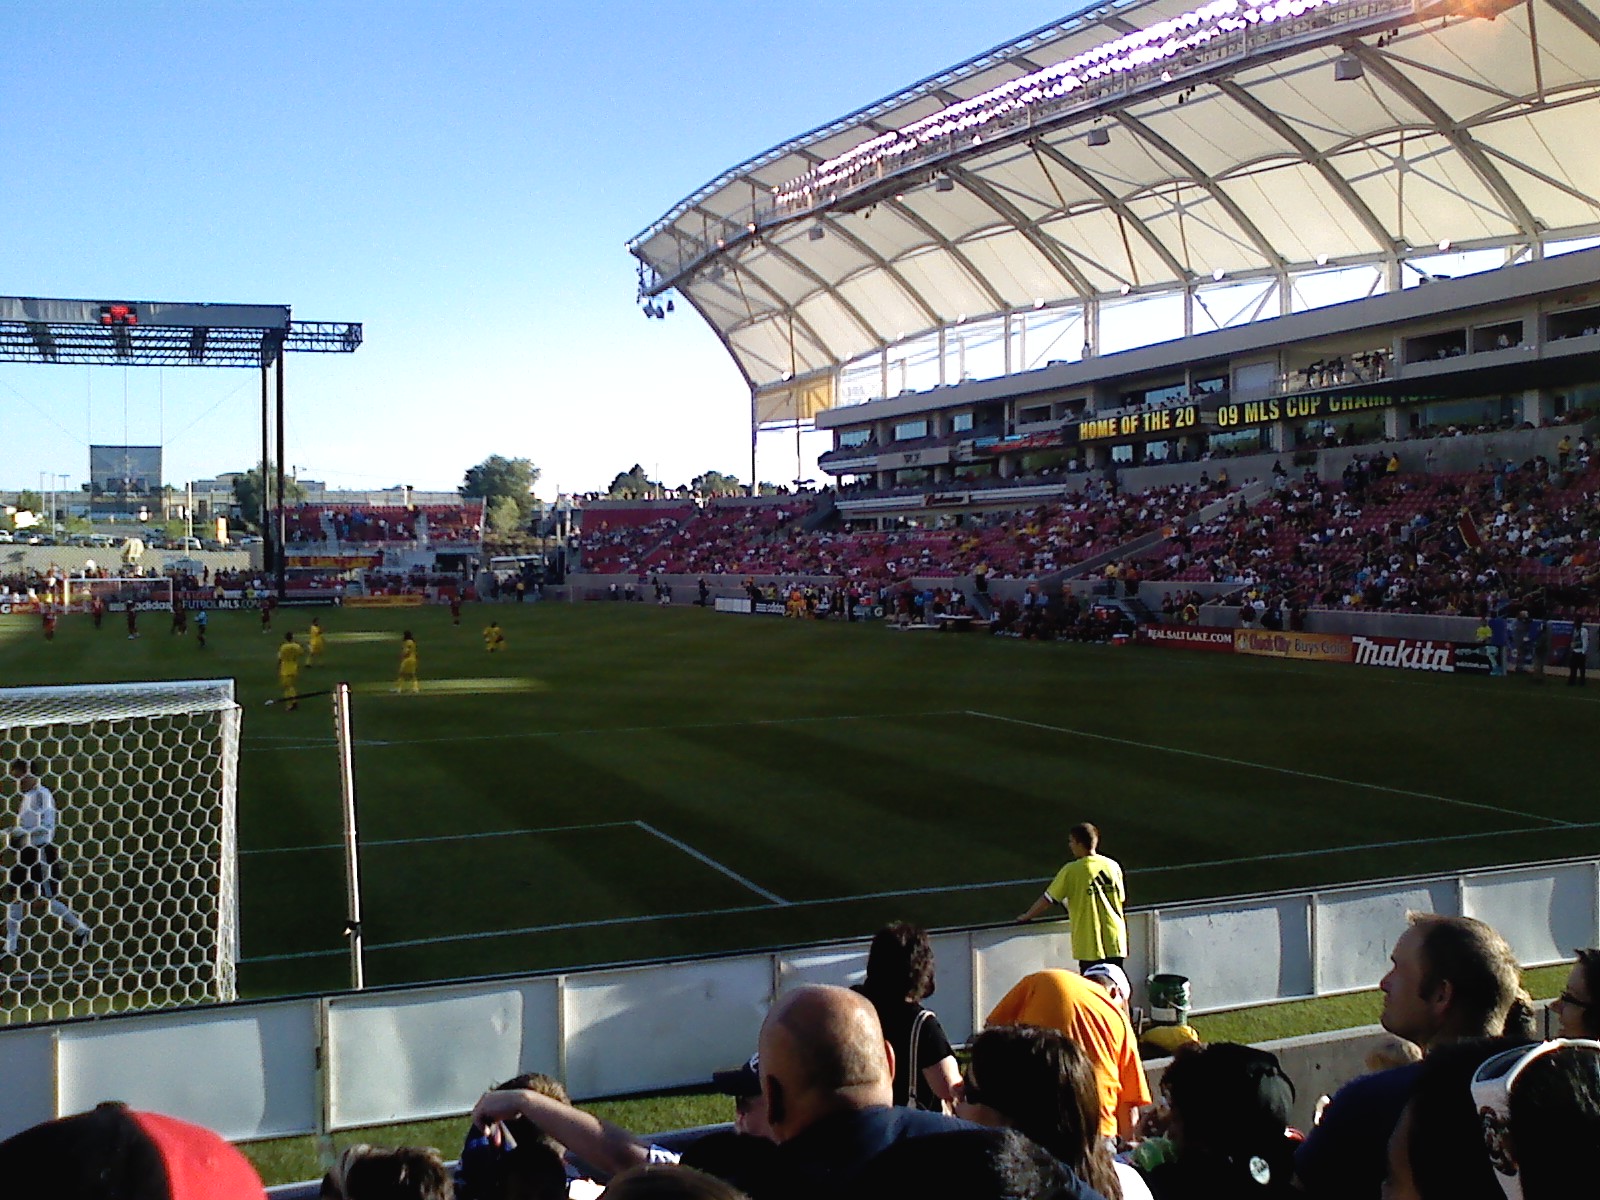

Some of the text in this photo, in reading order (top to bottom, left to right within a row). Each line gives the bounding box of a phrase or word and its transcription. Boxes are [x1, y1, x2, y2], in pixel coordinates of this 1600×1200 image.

[1079, 418, 1117, 441] HOME
[1120, 415, 1138, 435] OF
[1143, 410, 1170, 432] THE
[1175, 407, 1195, 427] 20
[1218, 407, 1238, 427] 09
[1245, 398, 1280, 423] MLS
[1286, 395, 1321, 418] CUP
[1352, 636, 1454, 672] Makita
